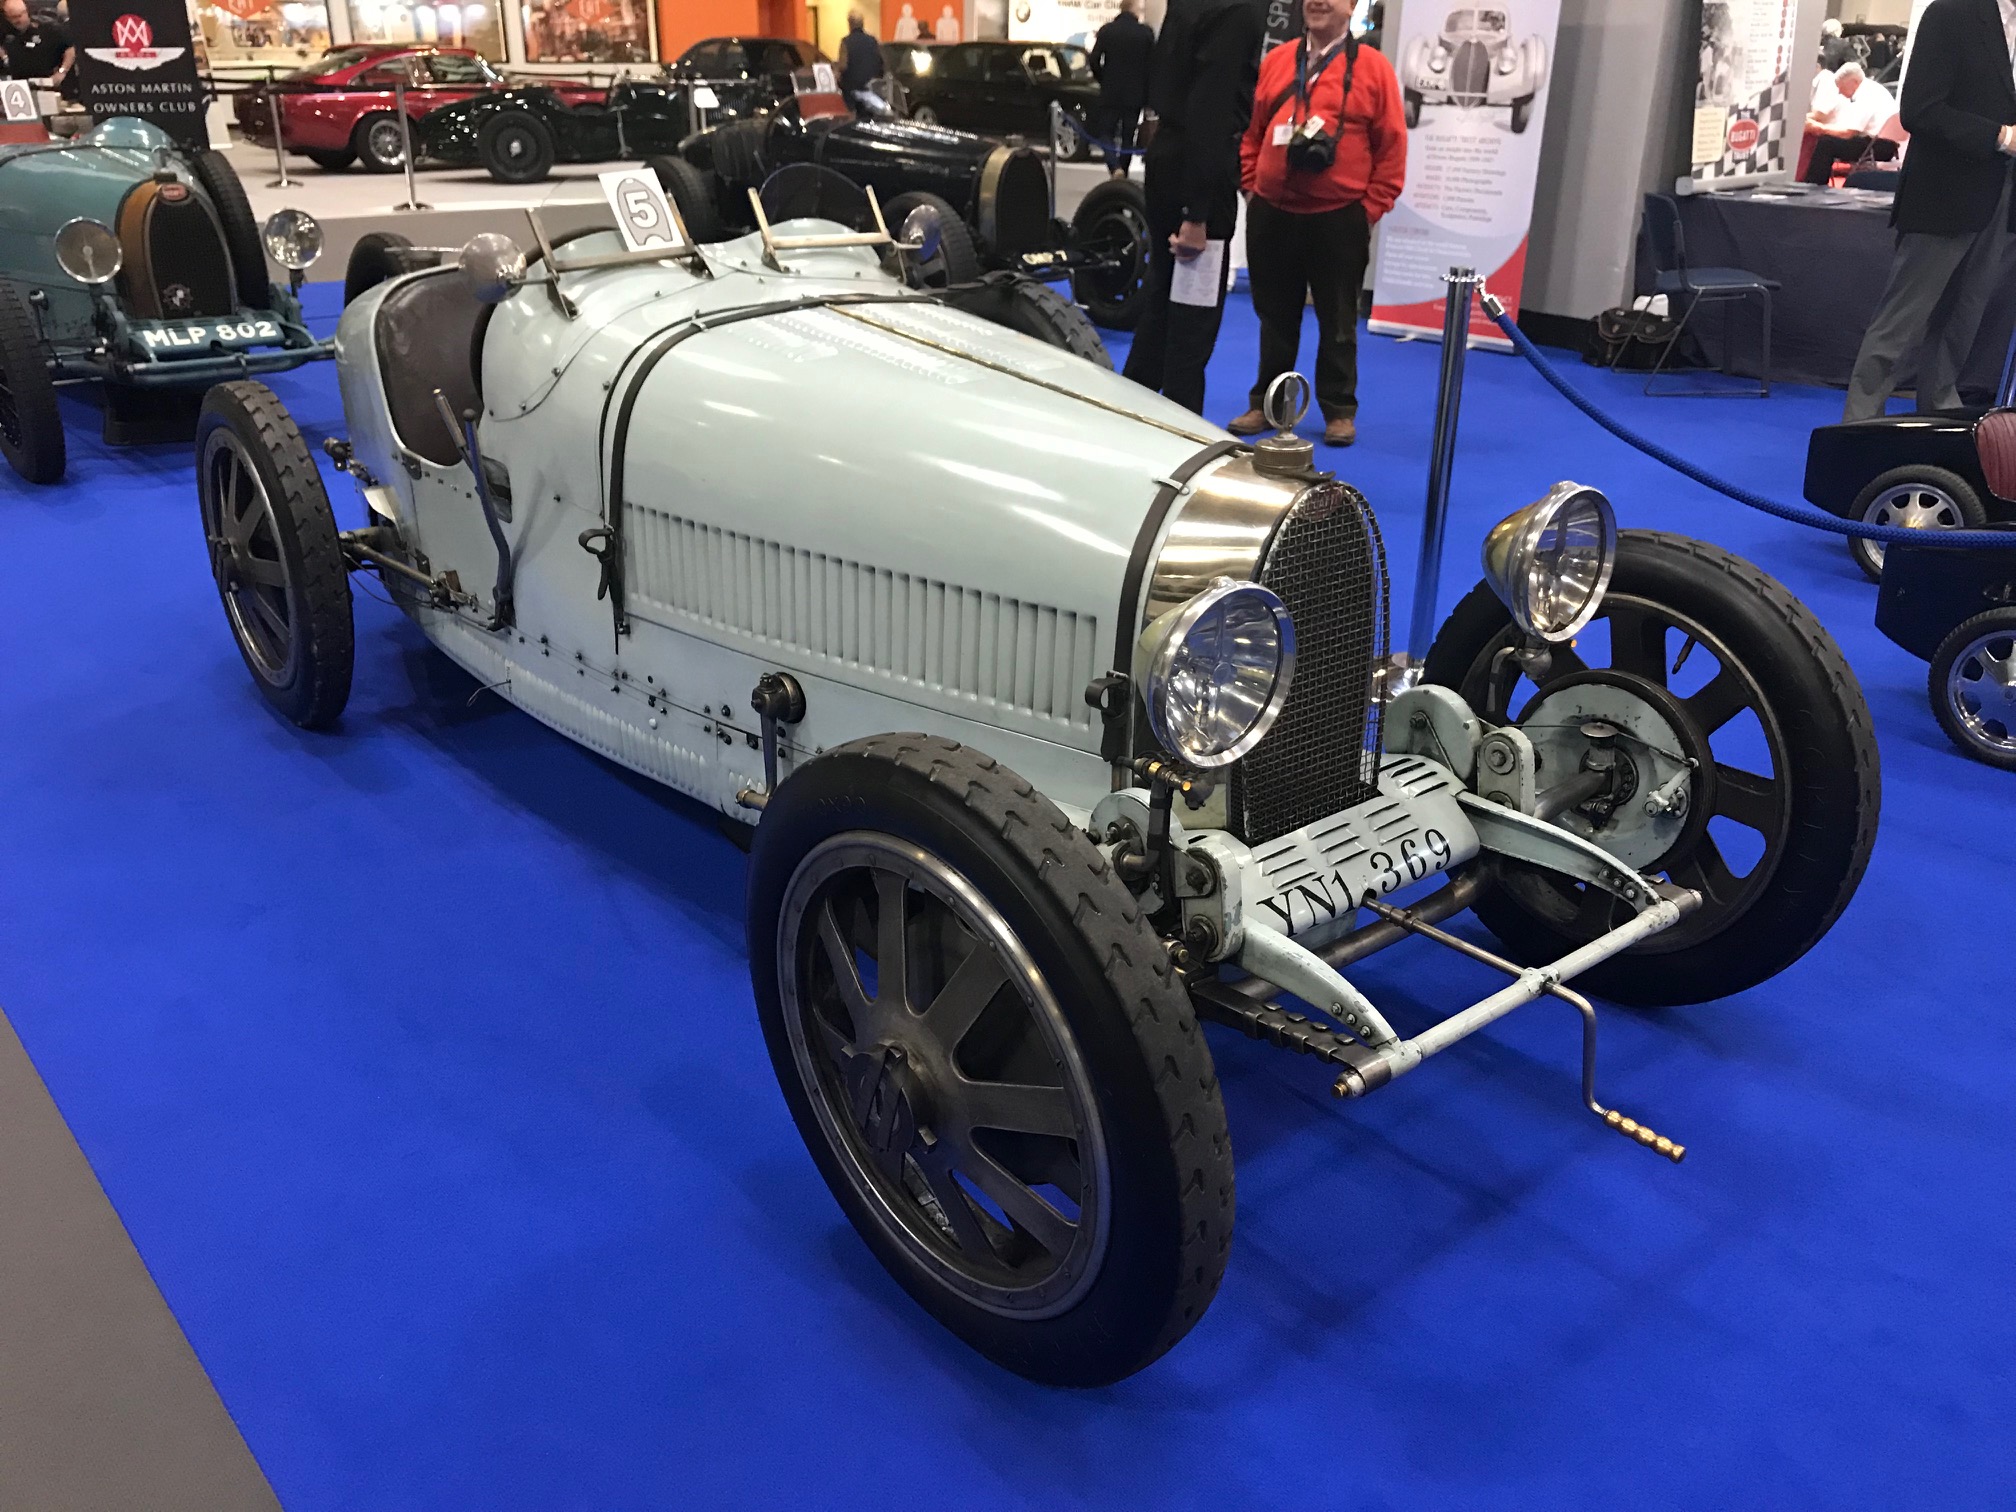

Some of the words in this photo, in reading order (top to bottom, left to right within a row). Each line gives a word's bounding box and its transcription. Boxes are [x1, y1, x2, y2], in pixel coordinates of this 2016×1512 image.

[11, 90, 25, 108] 4
[91, 83, 136, 94] ASTON
[141, 82, 192, 93] MARTIN
[93, 102, 153, 113] OWNERS
[159, 101, 196, 112] CLUB
[623, 189, 660, 229] 5
[142, 327, 206, 348] MLP
[216, 321, 277, 341] 802
[1256, 869, 1356, 938] YN1
[1370, 828, 1452, 894] 369
